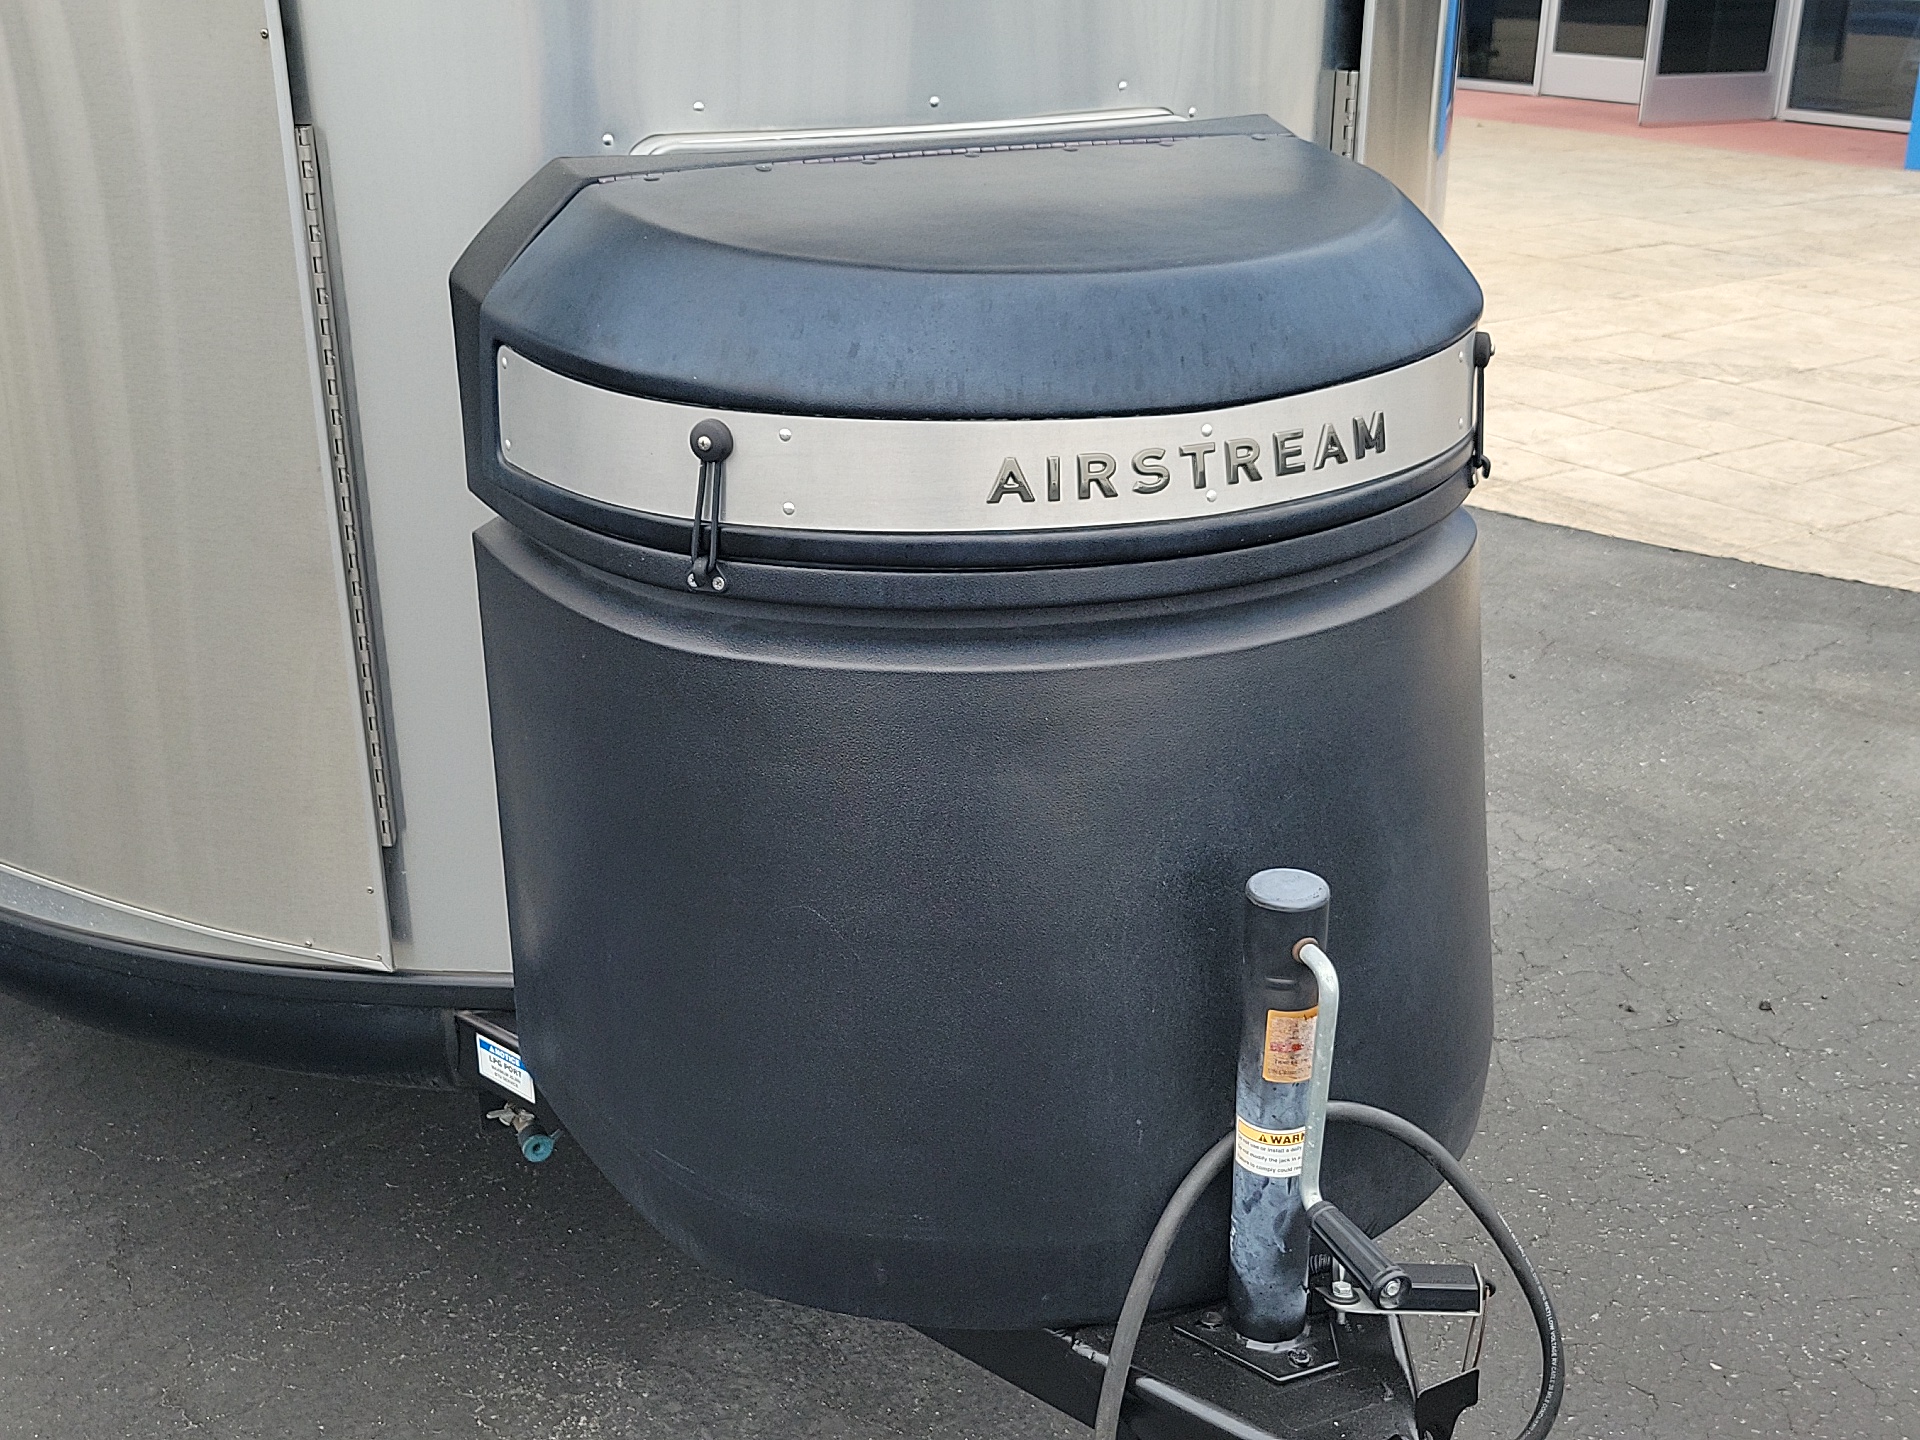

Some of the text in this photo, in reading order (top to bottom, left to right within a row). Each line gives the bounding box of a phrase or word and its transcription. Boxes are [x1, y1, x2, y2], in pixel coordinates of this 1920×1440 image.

[986, 410, 1387, 504] AIRSTREAM
[489, 1054, 522, 1078] LPG PORT
[494, 1046, 521, 1067] NOTICE
[1548, 1317, 1556, 1331] LOW
[1550, 1330, 1558, 1359] VOLTAGE
